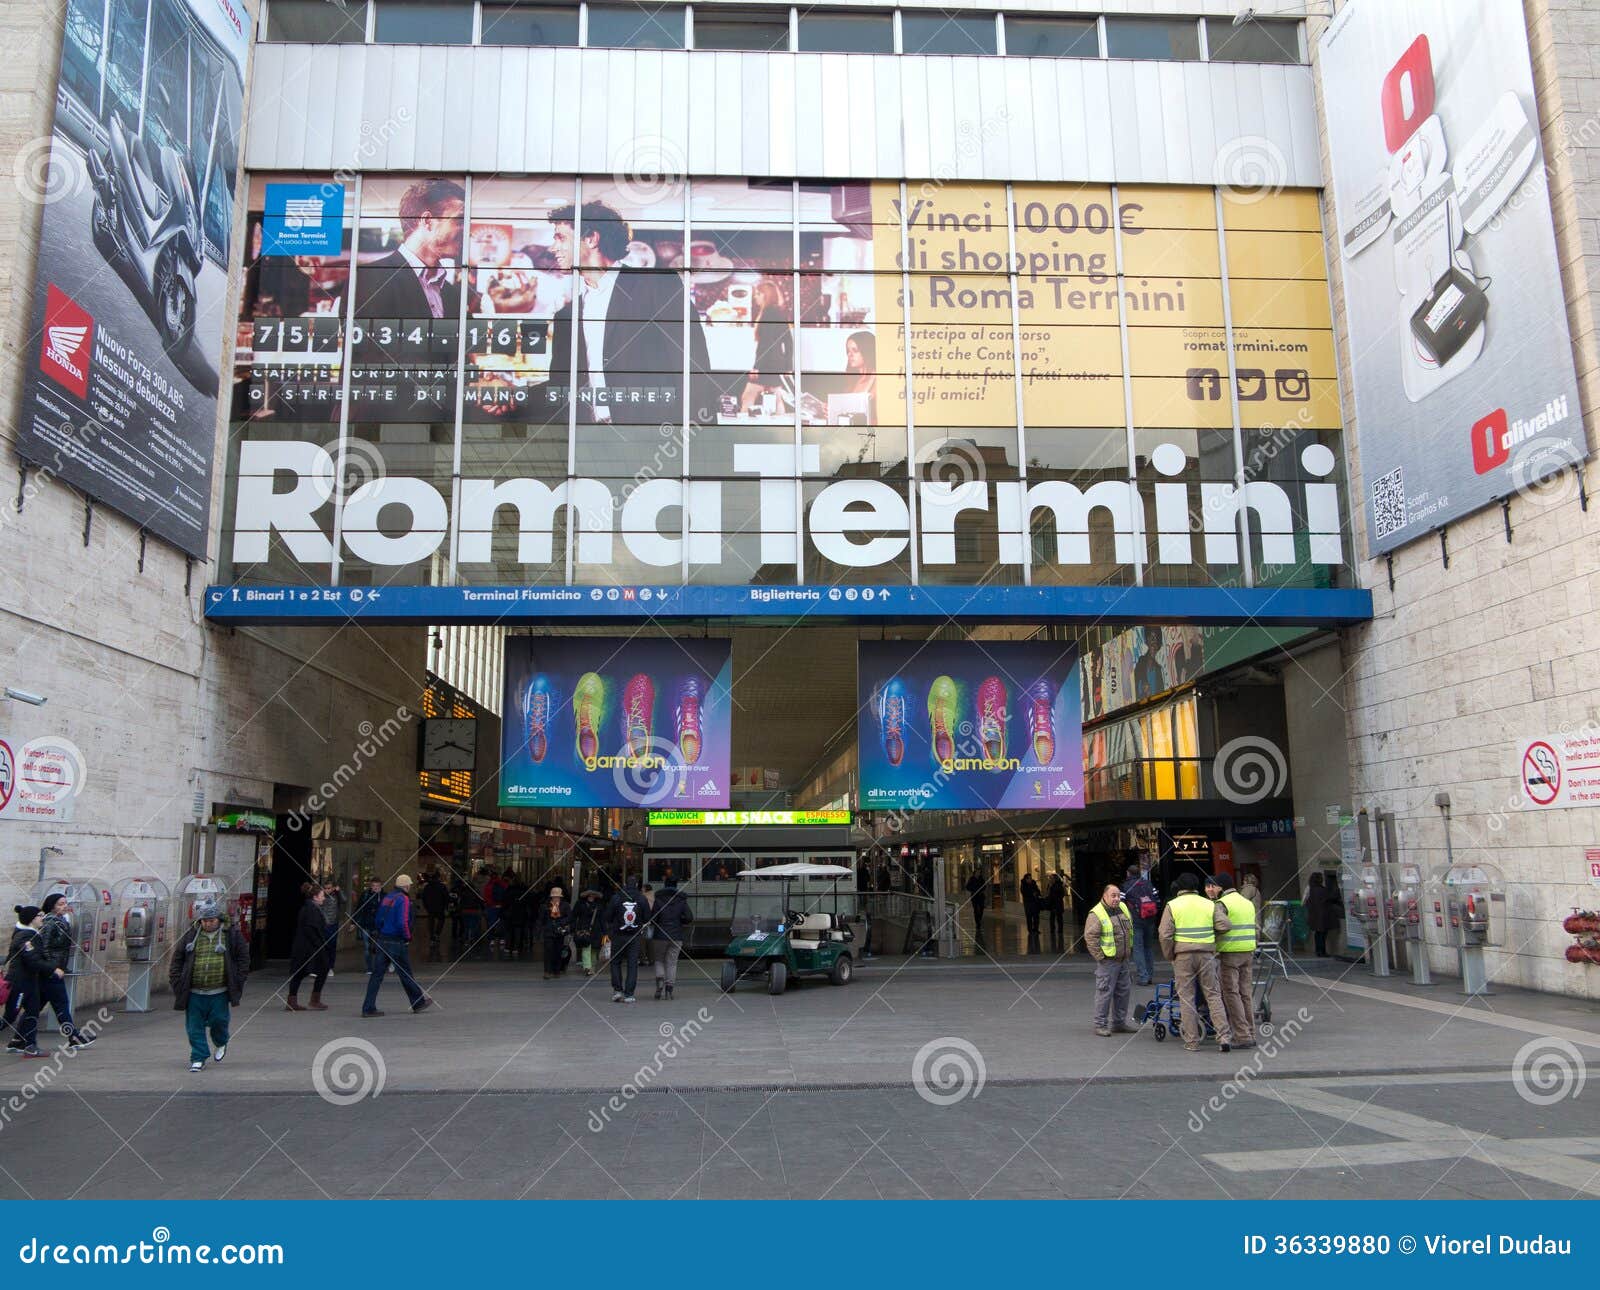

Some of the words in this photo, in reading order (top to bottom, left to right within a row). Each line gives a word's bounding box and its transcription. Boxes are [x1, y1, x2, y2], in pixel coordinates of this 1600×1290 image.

[892, 200, 992, 232] Vinci
[1005, 202, 1144, 235] 1000€
[1401, 187, 1447, 236] INNOVAZIONE
[896, 238, 928, 270] di
[941, 239, 1107, 285] shopping
[897, 290, 914, 308] a
[930, 276, 1034, 309] Roma
[1046, 278, 1185, 312] Termini
[971, 327, 985, 340] al
[989, 331, 1051, 341] conorso
[1184, 339, 1308, 352] romatrmini.com
[947, 346, 971, 360] che
[46, 346, 84, 382] HONDA
[97, 323, 126, 360] Nuovo
[128, 349, 151, 381] Forza
[153, 371, 167, 397] 300
[168, 385, 185, 412] ABS.
[352, 370, 475, 379] ORDINAI
[95, 343, 134, 389] Nessuna
[136, 379, 177, 424] debolezza.
[285, 389, 393, 401] STRETTE
[417, 390, 441, 401] DI
[465, 390, 527, 402] MANO
[940, 386, 986, 401] amici!
[1502, 394, 1568, 450] olivetti
[247, 590, 284, 600] Binari
[289, 590, 294, 600] 1
[300, 592, 307, 600] e
[311, 591, 320, 600] 2
[323, 590, 341, 600] Est
[463, 590, 518, 601] Terminal
[522, 590, 581, 601] Fiumicino
[750, 589, 820, 602] Biglietteria
[585, 756, 637, 771] game
[643, 757, 667, 769] on
[942, 757, 993, 774] game
[998, 757, 1021, 771] on
[508, 785, 518, 794] all
[519, 785, 528, 793] in
[528, 786, 537, 794] or
[538, 785, 572, 796] nothing
[868, 789, 878, 797] all
[879, 789, 887, 797] in
[898, 789, 930, 799] nothing
[1578, 791, 1589, 801] the
[25, 805, 35, 813] the
[36, 807, 55, 815] station
[650, 812, 698, 820] SANDWICH
[705, 812, 737, 825] BAR
[742, 811, 793, 824] SNACK
